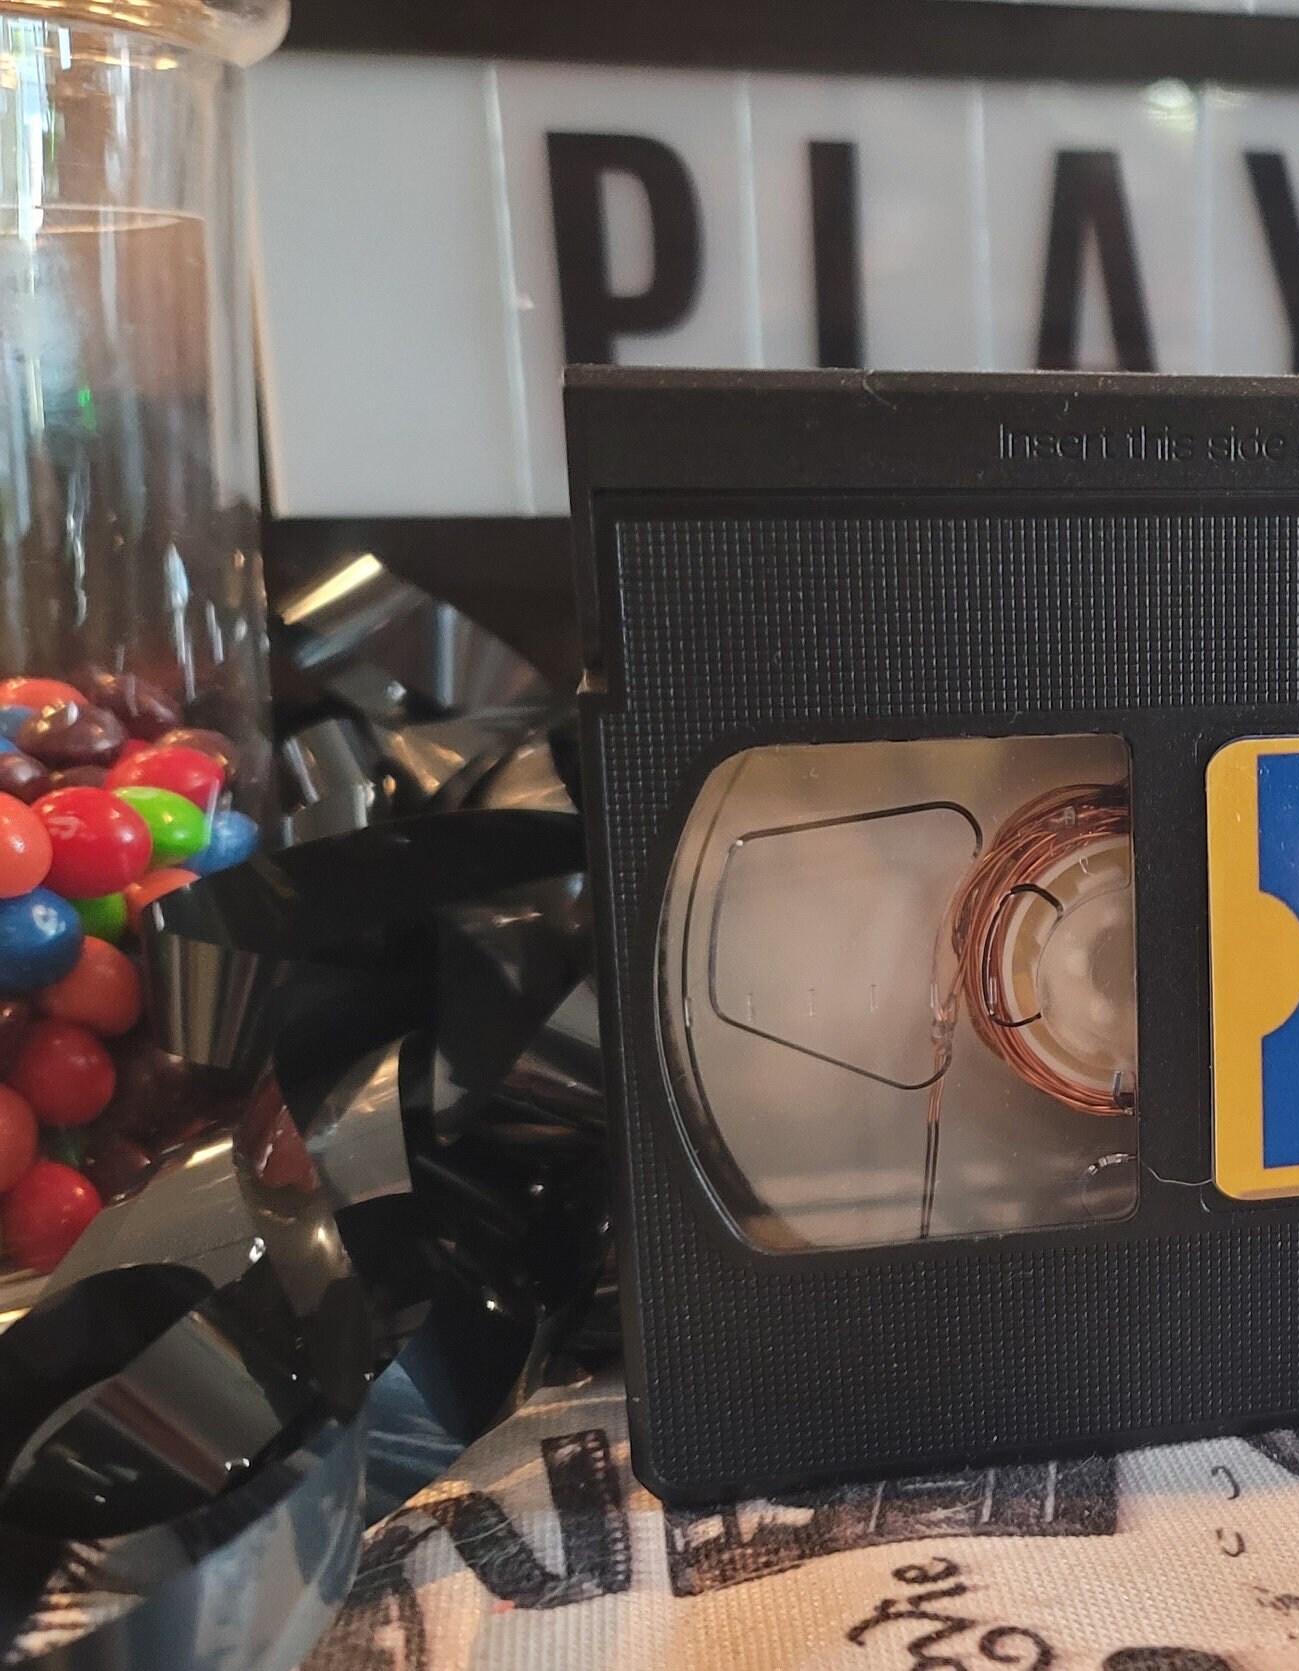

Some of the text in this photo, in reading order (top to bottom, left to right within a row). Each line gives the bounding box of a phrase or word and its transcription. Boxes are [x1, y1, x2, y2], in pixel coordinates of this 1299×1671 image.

[998, 423, 1108, 461] Insert
[1126, 425, 1193, 462] this
[1207, 425, 1286, 462] side
